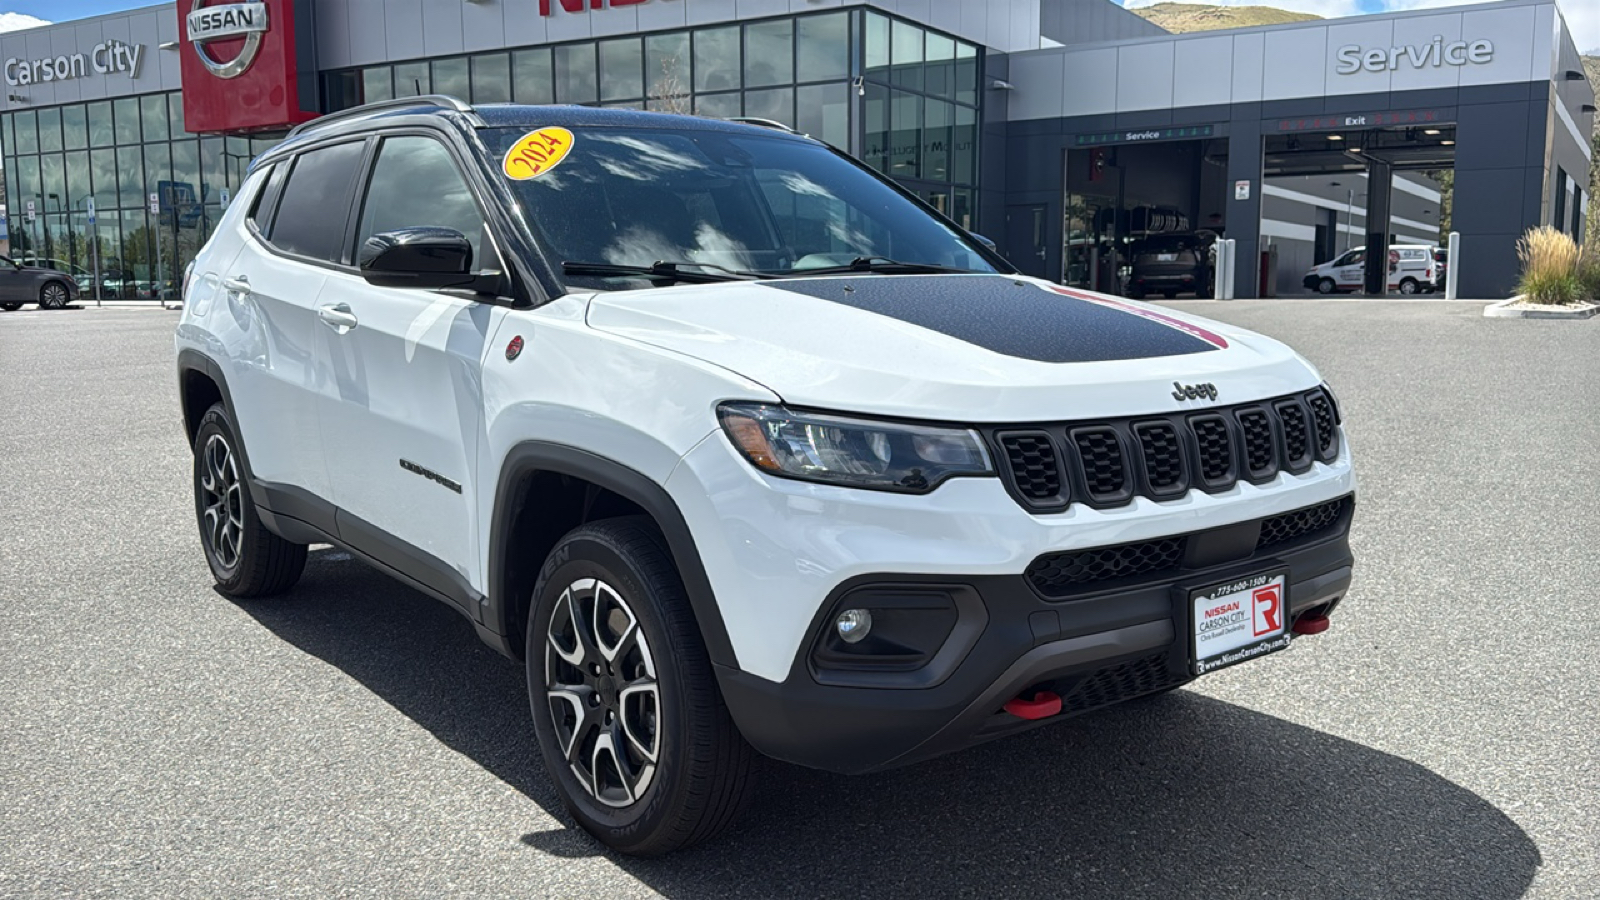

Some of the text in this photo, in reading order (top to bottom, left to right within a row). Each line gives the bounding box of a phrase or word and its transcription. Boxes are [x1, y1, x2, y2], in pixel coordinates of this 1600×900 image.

[189, 8, 253, 34] NISSAN
[4, 39, 142, 86] Carson City
[1336, 35, 1495, 75] Service
[1345, 115, 1366, 126] Exit
[1125, 130, 1160, 141] Service
[512, 132, 562, 173] 2024
[1171, 381, 1218, 401] Jeep
[1217, 576, 1266, 596] 775-600-1500
[1204, 601, 1240, 619] NISSAN
[1199, 610, 1245, 632] CARSON CITY
